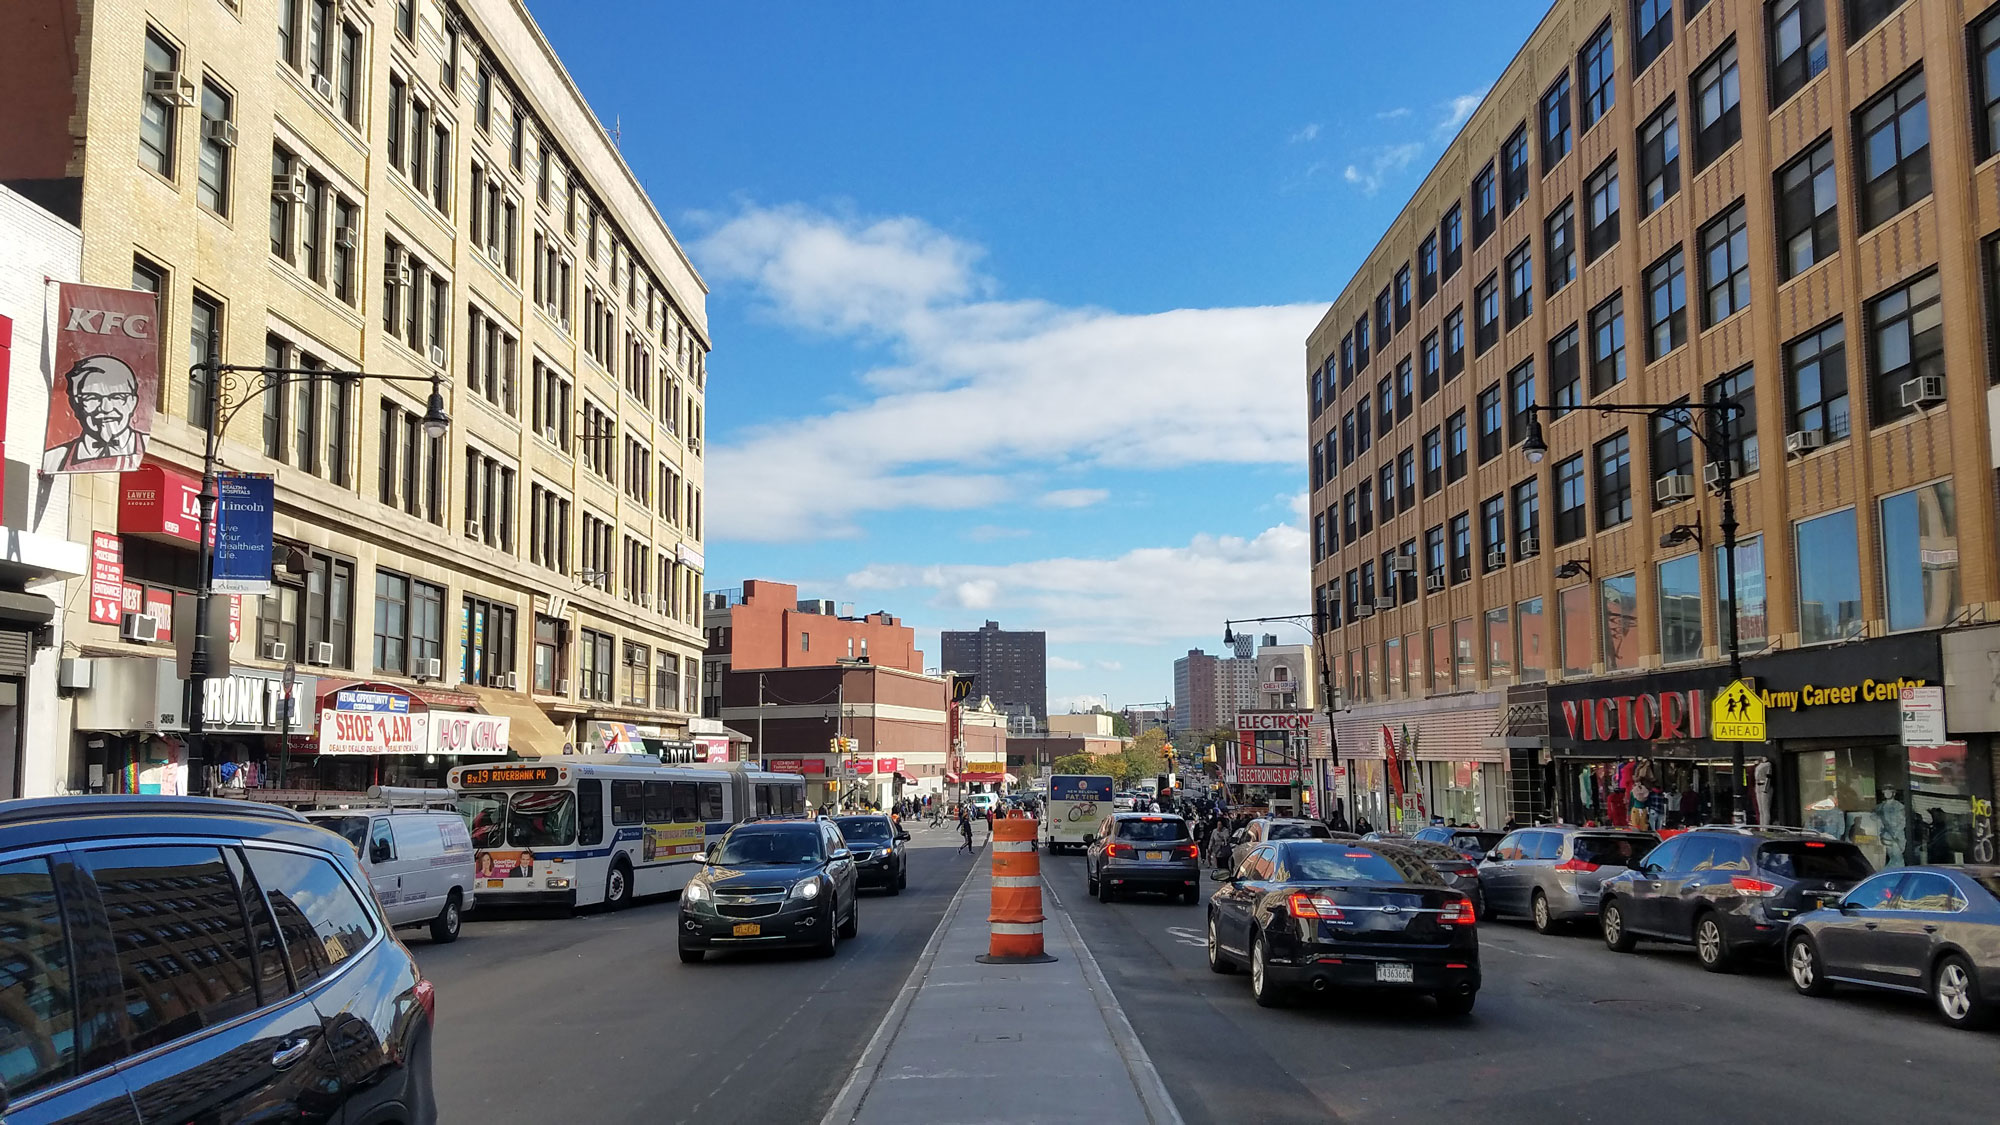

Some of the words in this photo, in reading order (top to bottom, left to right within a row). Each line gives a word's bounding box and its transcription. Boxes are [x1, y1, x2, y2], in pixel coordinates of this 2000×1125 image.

[64, 307, 149, 338] KFC
[127, 491, 155, 499] LAWYER
[222, 501, 264, 512] Lincoln
[220, 524, 239, 532] Live
[220, 533, 241, 541] Your
[219, 541, 265, 551] Healthiest
[219, 551, 238, 559] Life.
[94, 582, 121, 597] ENTRANCE
[202, 675, 264, 725] RONX
[1762, 689, 1798, 712] Army
[1803, 684, 1858, 706] Career
[1561, 689, 1706, 741] VICTORI
[1905, 711, 1913, 721] 2
[336, 713, 374, 742] SHOE
[439, 719, 469, 749] HOT
[472, 721, 502, 750] CHIC
[1720, 725, 1760, 736] AHEAD
[467, 770, 489, 784] Bx19
[492, 769, 534, 781] RIVERBANK
[536, 769, 547, 780] PK
[1239, 768, 1281, 783] ELECTRONICS
[1282, 769, 1287, 782] &
